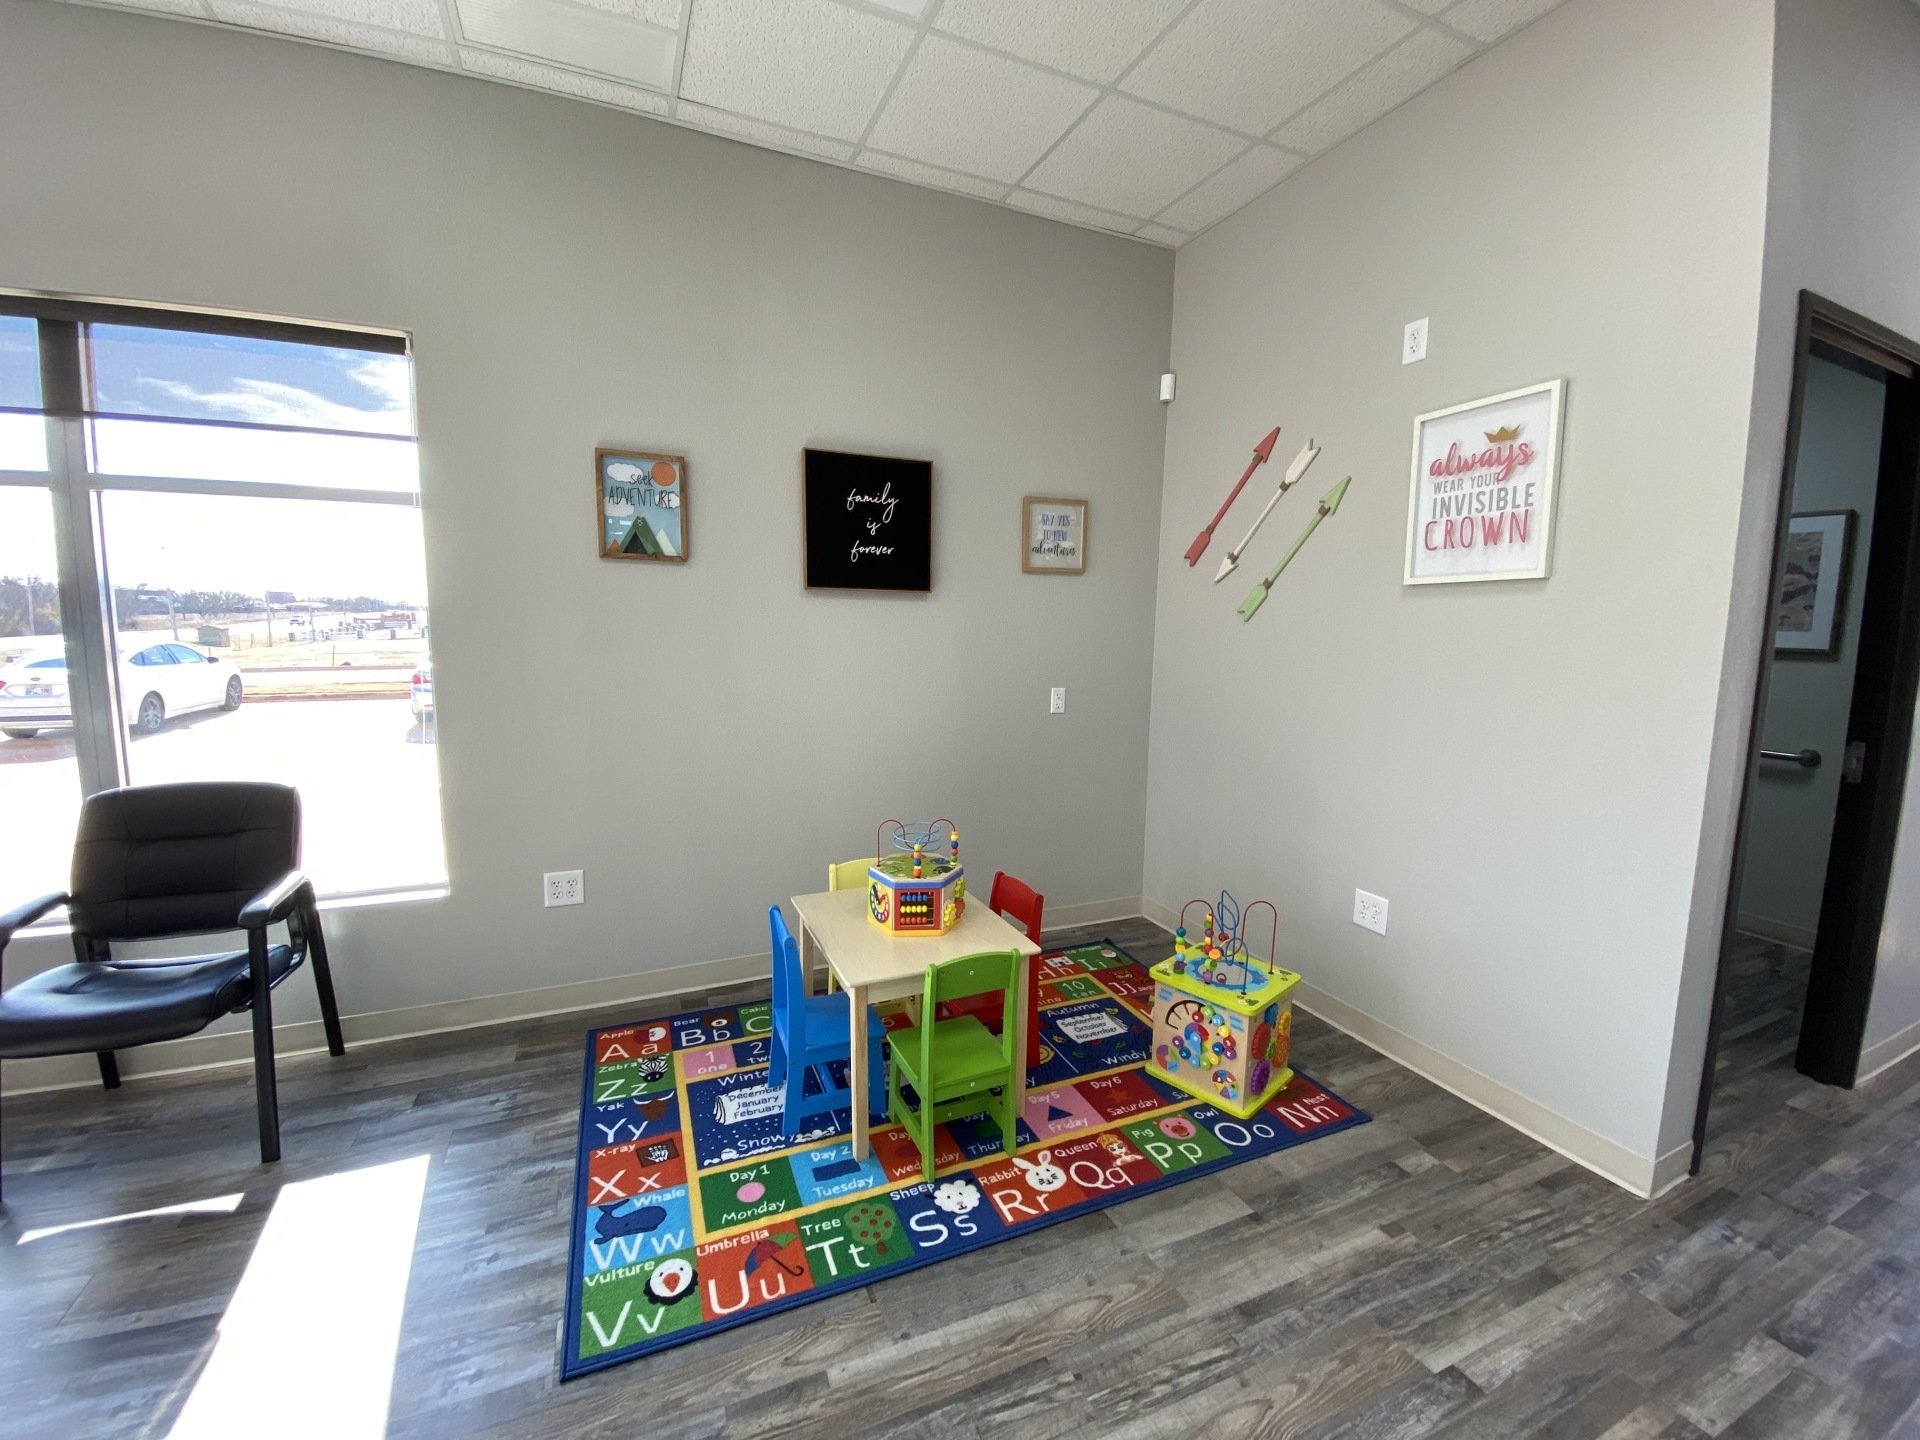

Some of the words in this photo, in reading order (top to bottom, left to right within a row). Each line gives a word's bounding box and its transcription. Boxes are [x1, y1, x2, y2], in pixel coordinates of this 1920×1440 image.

[1429, 441, 1534, 482] always
[630, 471, 653, 487] seek
[1433, 478, 1464, 494] WEAR
[1470, 472, 1500, 488] YOUR
[608, 485, 675, 509] ADVENTURE
[847, 481, 899, 523] family
[1432, 482, 1536, 520] INVISIBLE
[866, 517, 881, 535] is
[1041, 514, 1055, 526] SAY
[1058, 514, 1070, 527] YES
[1043, 530, 1051, 541] TO
[1053, 530, 1067, 541] NEW
[1424, 509, 1529, 552] CROWN
[850, 540, 894, 563] forever
[1062, 980, 1085, 992] 10
[1072, 990, 1096, 999] ten
[741, 1006, 768, 1015] Cake
[1047, 1003, 1100, 1017] Autumn
[673, 1018, 699, 1026] Bear
[882, 1018, 895, 1027] 5
[1060, 1015, 1105, 1028] September
[1073, 1021, 1107, 1033] October
[600, 1029, 635, 1040] Apple
[1075, 1027, 1117, 1040] November
[750, 1042, 765, 1055] 2
[705, 1051, 715, 1063] 1
[747, 1055, 771, 1064] tw
[1101, 1050, 1147, 1065] Windy
[599, 1061, 638, 1074] Zebra
[697, 1063, 728, 1074] one
[717, 1070, 769, 1086] Winte
[1090, 1079, 1112, 1090] Day
[1113, 1076, 1121, 1084] 6
[728, 1085, 785, 1102] December
[1028, 1095, 1050, 1105] Day
[1050, 1091, 1060, 1099] 5
[1302, 1092, 1331, 1106] Nest
[597, 1102, 624, 1112] Yak
[736, 1095, 780, 1110] January
[1107, 1098, 1159, 1116] Saturday
[734, 1103, 784, 1119] February
[1193, 1107, 1219, 1120] Owl
[1047, 1117, 1089, 1133] Friday
[1132, 1126, 1155, 1139] Pig
[888, 1130, 913, 1142] Day
[595, 1143, 636, 1158] X-ray
[967, 1132, 1031, 1156] Thuray
[1054, 1140, 1099, 1158] Queen
[811, 1149, 837, 1162] Day
[840, 1146, 851, 1155] 2
[892, 1151, 960, 1177] Wedsday
[730, 1168, 757, 1182] Day
[759, 1164, 770, 1175] 1
[978, 1166, 1022, 1186] Rabbit
[812, 1175, 874, 1198] Tuesday
[889, 1183, 935, 1201] Sheep
[633, 1188, 686, 1208] Whale
[721, 1199, 786, 1224] Monday
[801, 1218, 842, 1236] Tree
[696, 1228, 770, 1257] Umbrella
[585, 1261, 656, 1288] Vulture
